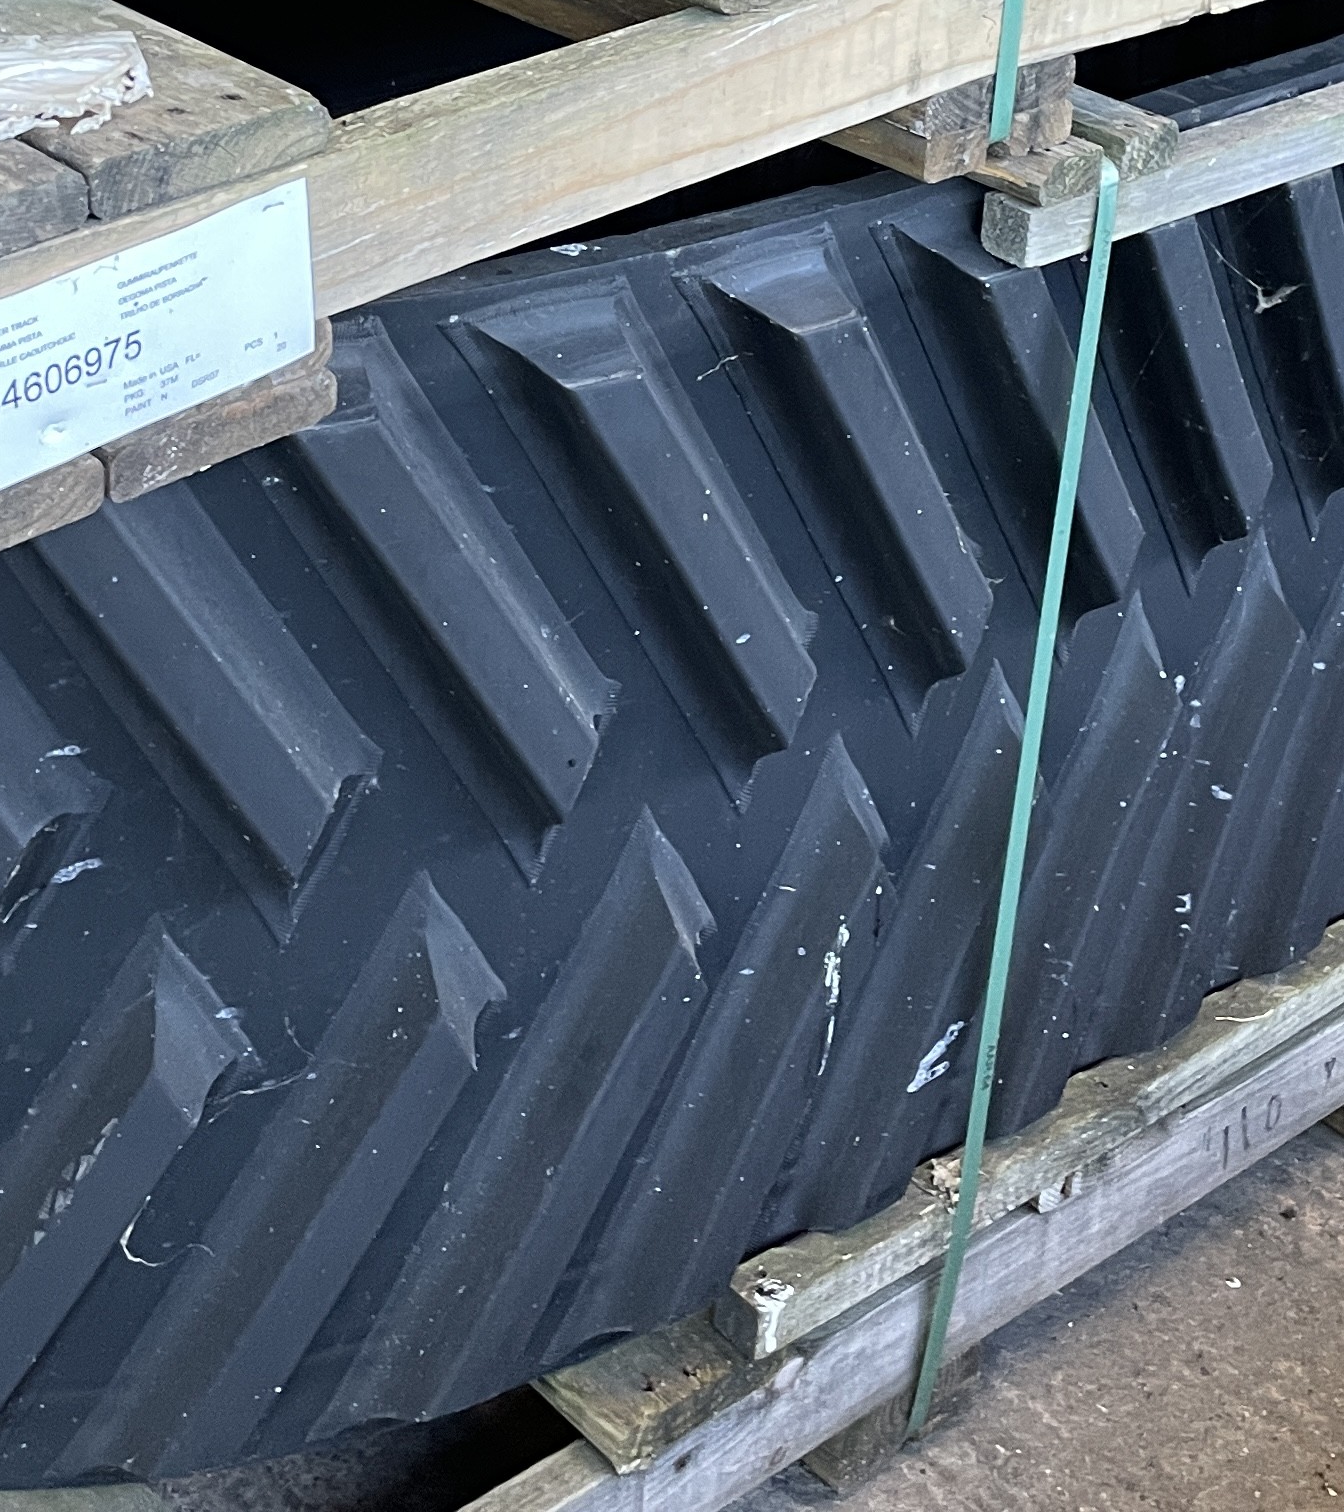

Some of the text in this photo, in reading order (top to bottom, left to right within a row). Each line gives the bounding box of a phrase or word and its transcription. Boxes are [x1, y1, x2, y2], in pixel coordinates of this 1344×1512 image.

[149, 299, 161, 309] DE
[11, 315, 39, 331] TRACK
[18, 330, 43, 345] PISTA
[244, 337, 264, 352] PCS
[19, 331, 76, 361] CAOUTCHOUC
[123, 374, 148, 390] Made
[159, 361, 180, 376] USA
[124, 398, 153, 417] PAINT
